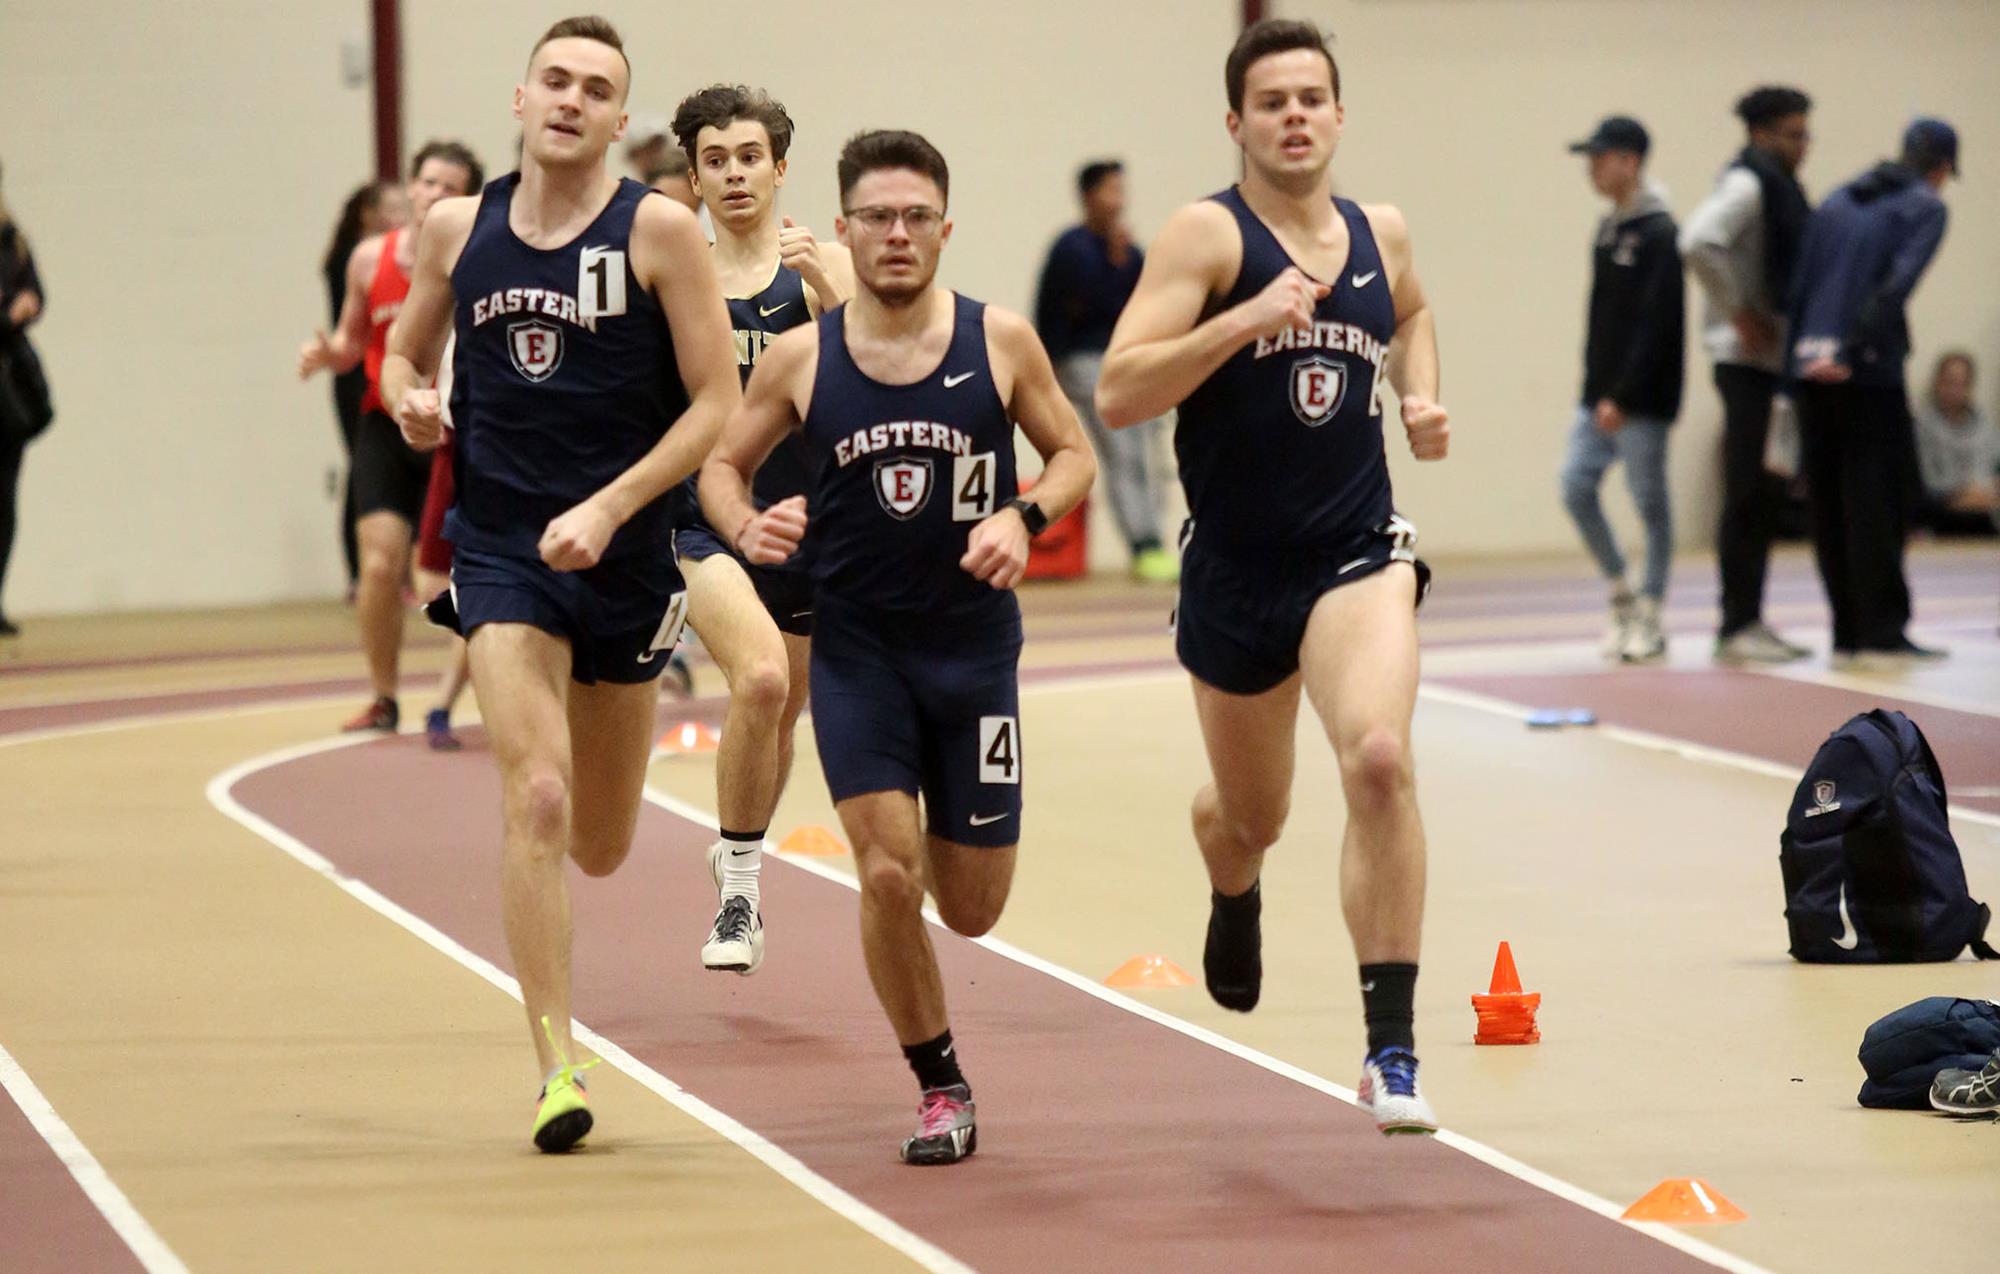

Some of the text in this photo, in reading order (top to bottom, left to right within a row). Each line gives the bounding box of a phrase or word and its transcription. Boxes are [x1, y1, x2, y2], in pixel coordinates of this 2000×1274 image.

[587, 257, 607, 311] 1
[526, 334, 545, 364] E
[1308, 373, 1326, 406] E
[834, 421, 972, 468] EASTERN
[894, 471, 913, 502] E
[959, 459, 988, 514] 4
[986, 722, 1013, 777] 4
